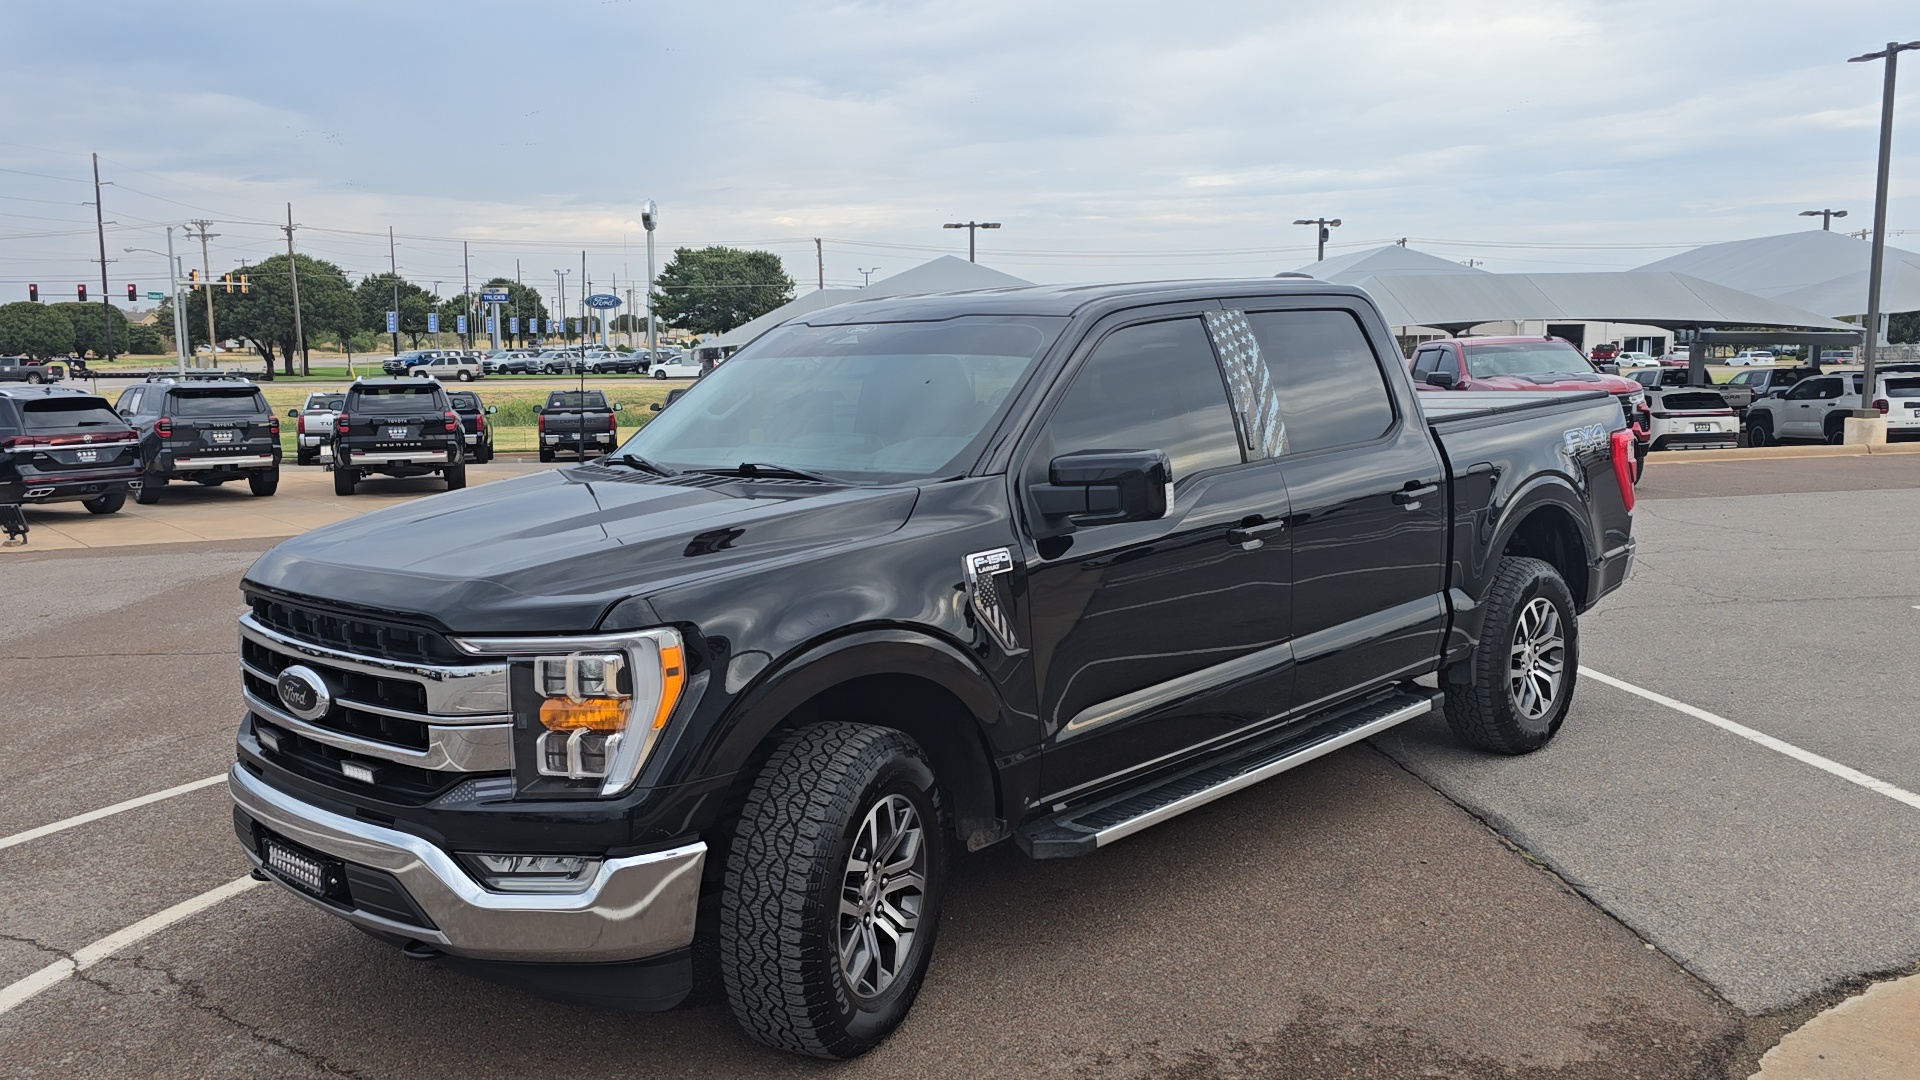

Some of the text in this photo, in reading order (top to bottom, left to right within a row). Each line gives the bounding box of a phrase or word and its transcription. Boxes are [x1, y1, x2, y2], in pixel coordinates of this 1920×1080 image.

[593, 297, 615, 306] Ford
[1563, 423, 1607, 457] FX4
[974, 552, 1010, 568] F-150
[978, 564, 1000, 573] LARIAT
[283, 680, 308, 706] Ford
